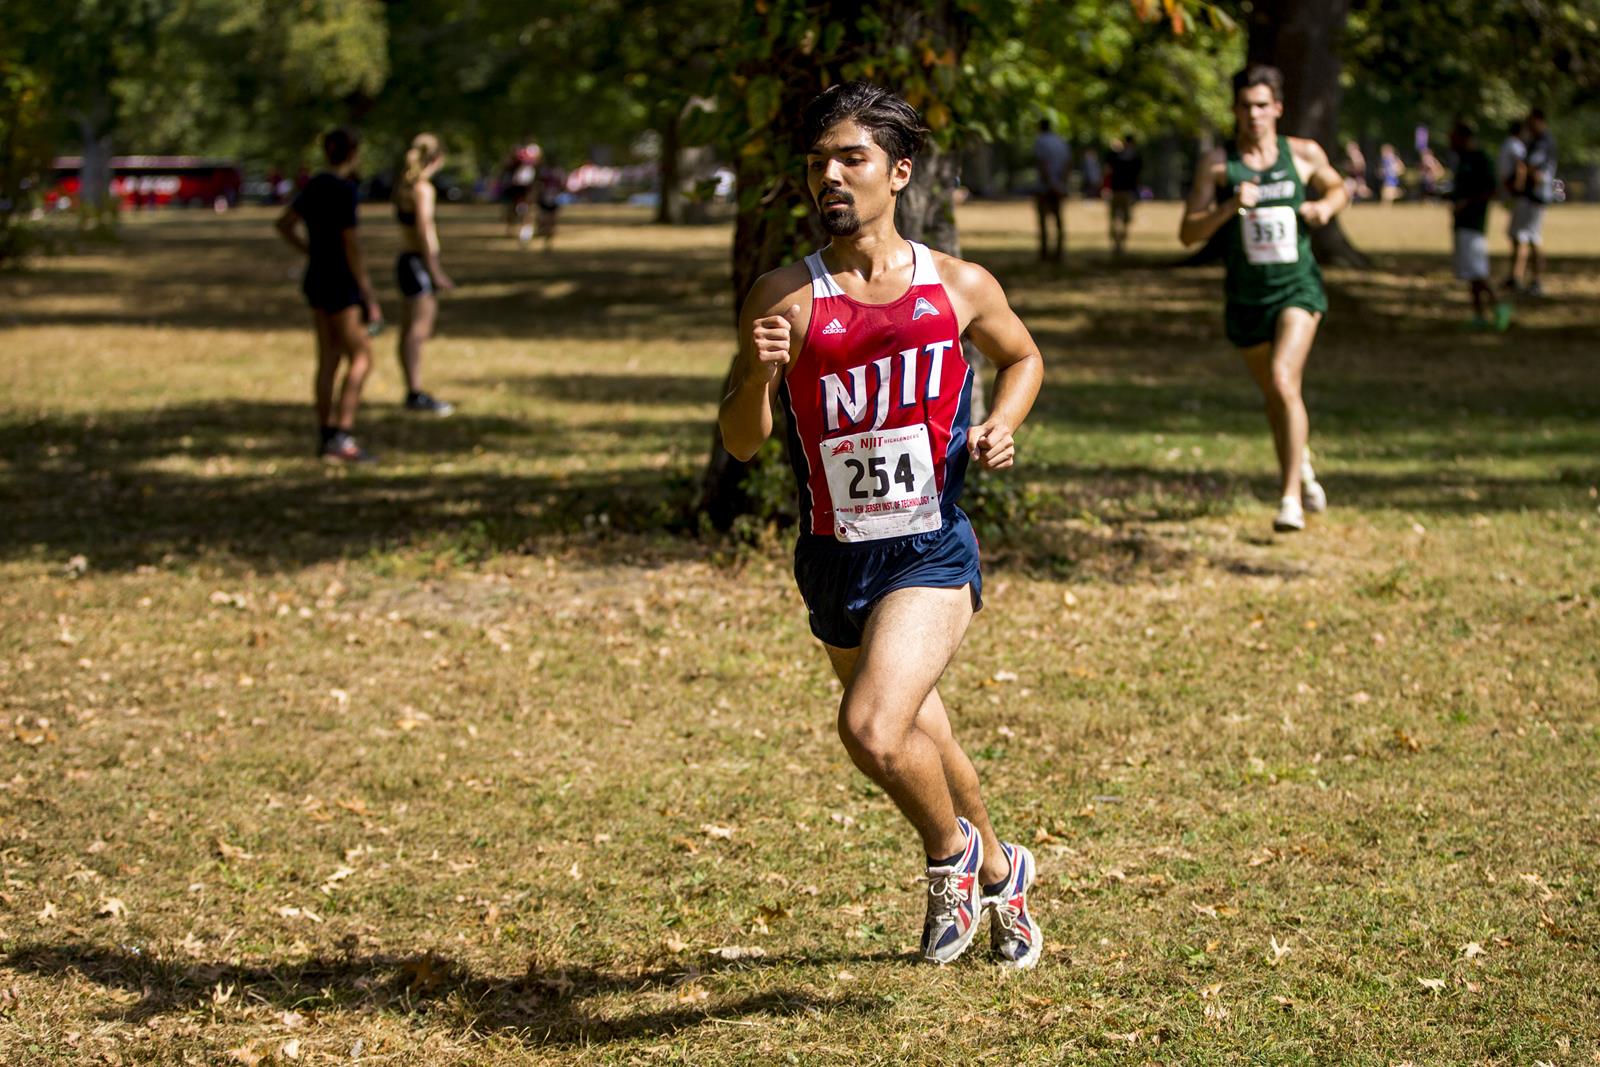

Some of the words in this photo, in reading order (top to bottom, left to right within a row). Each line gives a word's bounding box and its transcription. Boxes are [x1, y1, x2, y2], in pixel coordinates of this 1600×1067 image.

[1253, 221, 1285, 243] 353
[820, 340, 953, 432] NJIT
[860, 437, 884, 450] NJIT
[844, 453, 915, 499] 254
[854, 504, 865, 514] NEW
[865, 502, 881, 513] JERSEY
[882, 501, 895, 511] INST.
[894, 499, 901, 509] OF
[901, 495, 930, 509] TECHNOLOGY
